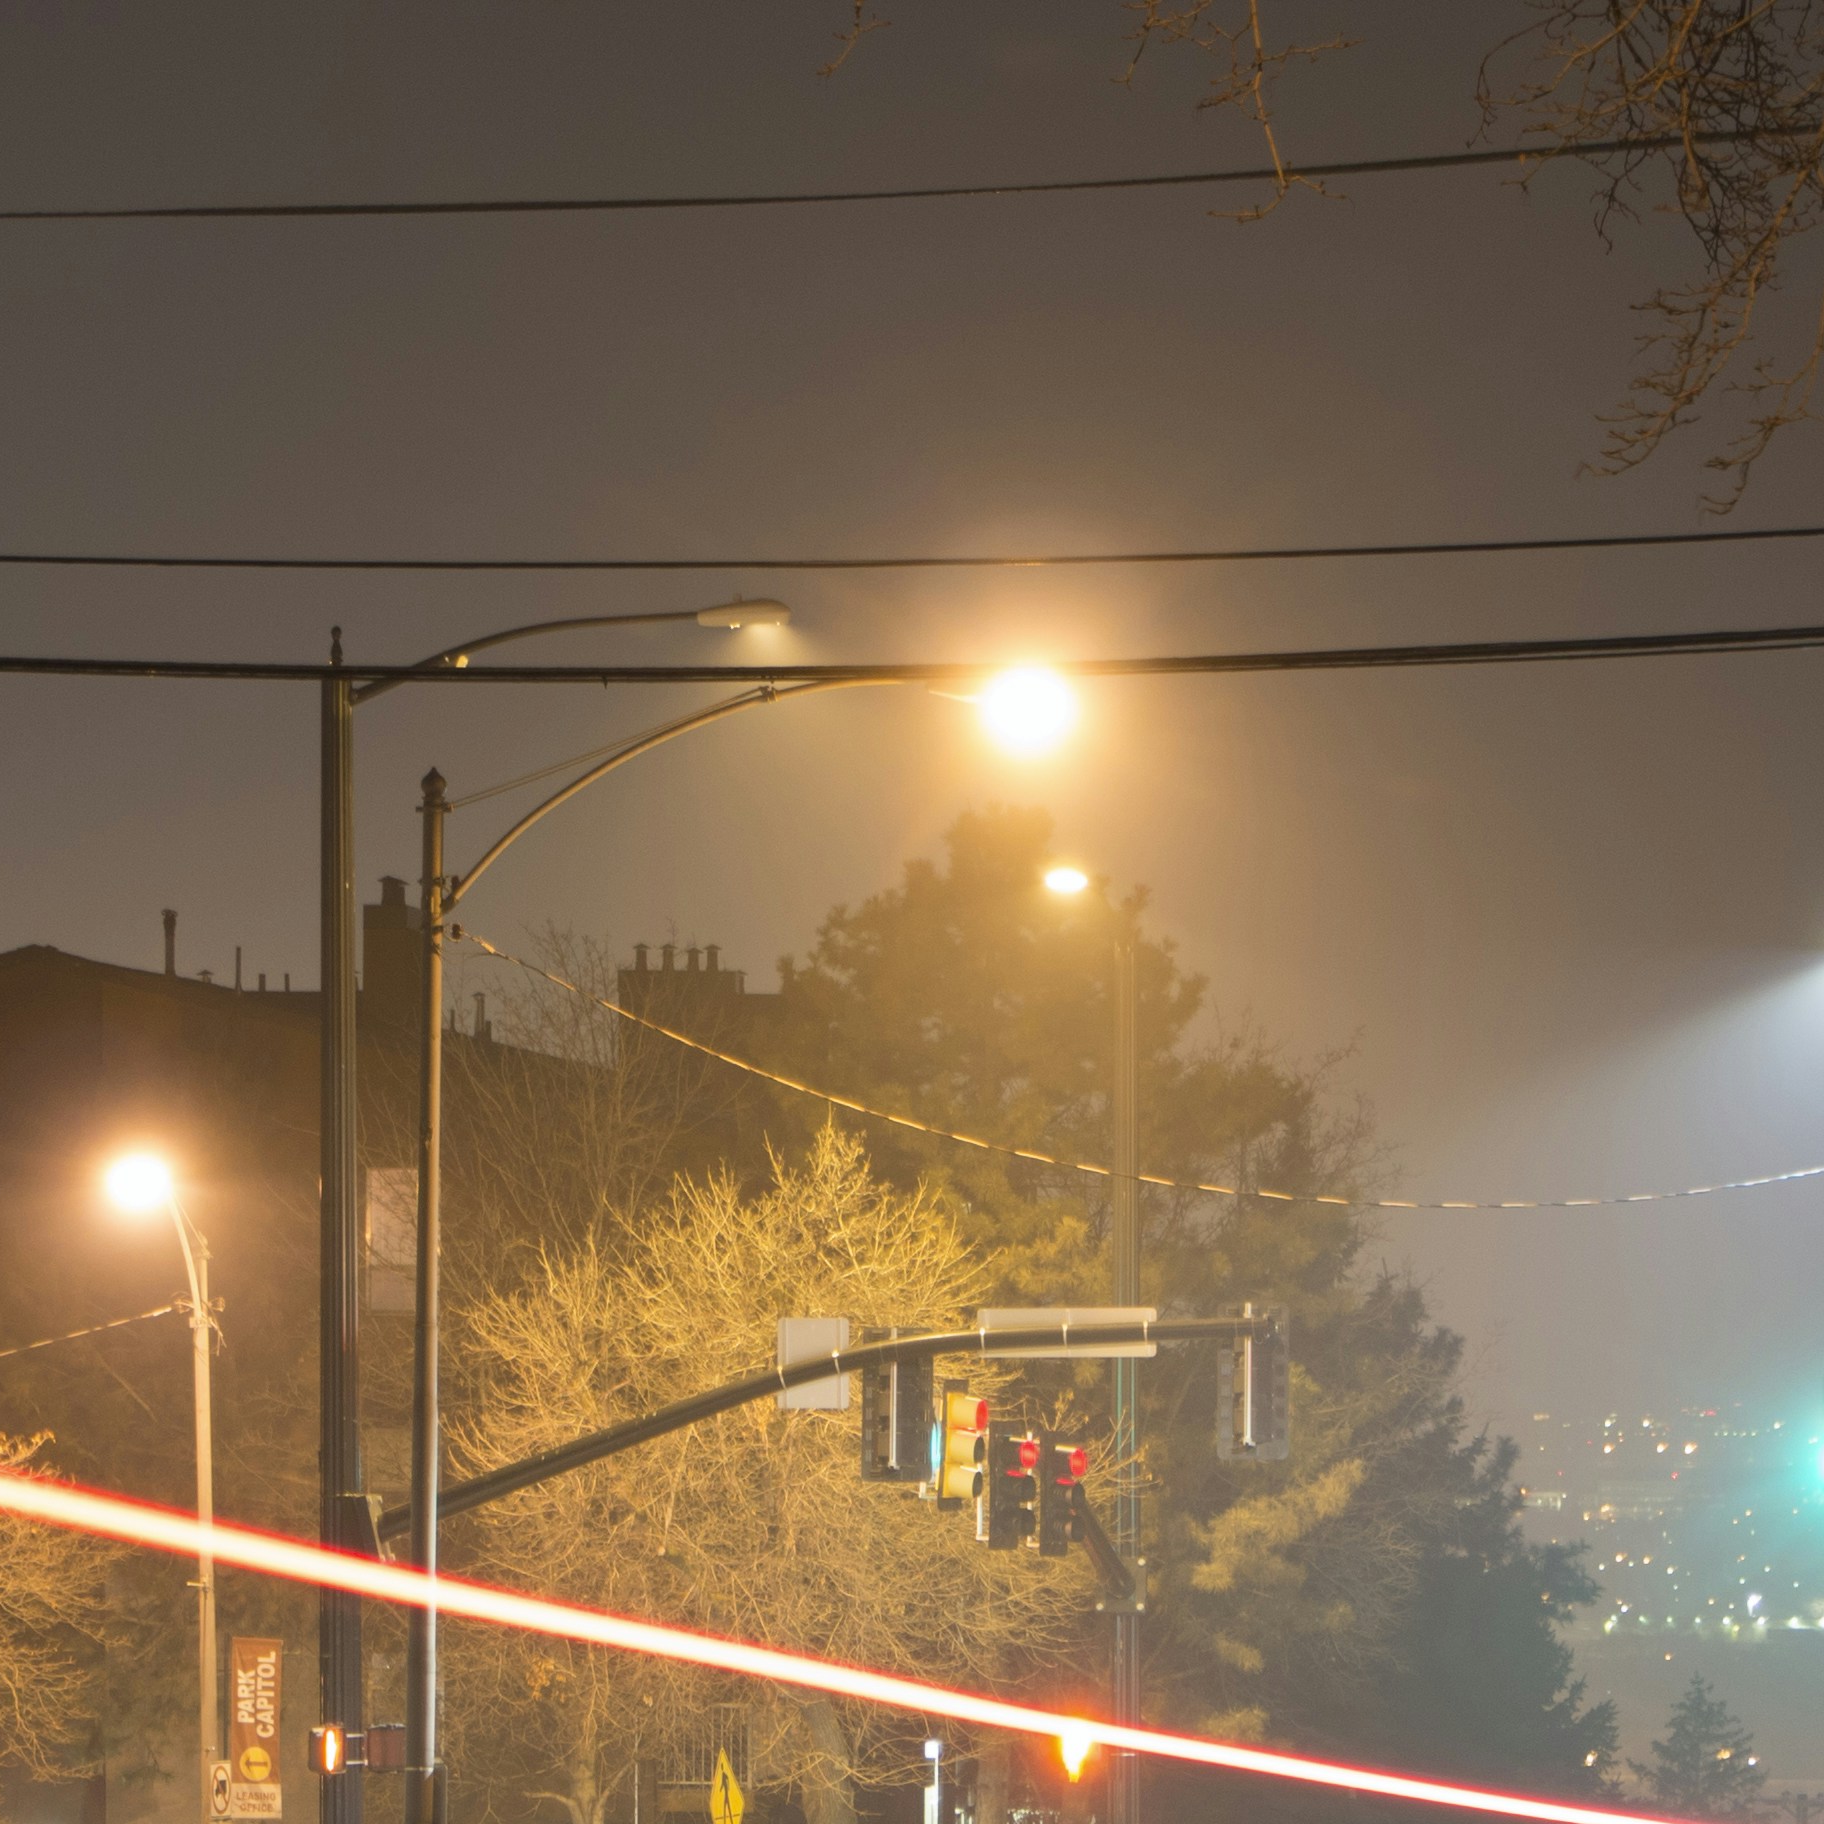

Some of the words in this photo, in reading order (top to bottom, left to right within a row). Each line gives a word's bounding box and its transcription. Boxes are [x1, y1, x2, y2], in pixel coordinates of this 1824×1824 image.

[237, 1668, 256, 1724] PARK
[256, 1650, 276, 1738] CAPITOL
[236, 1791, 276, 1801] LEASING
[239, 1803, 273, 1812] OFFICE
